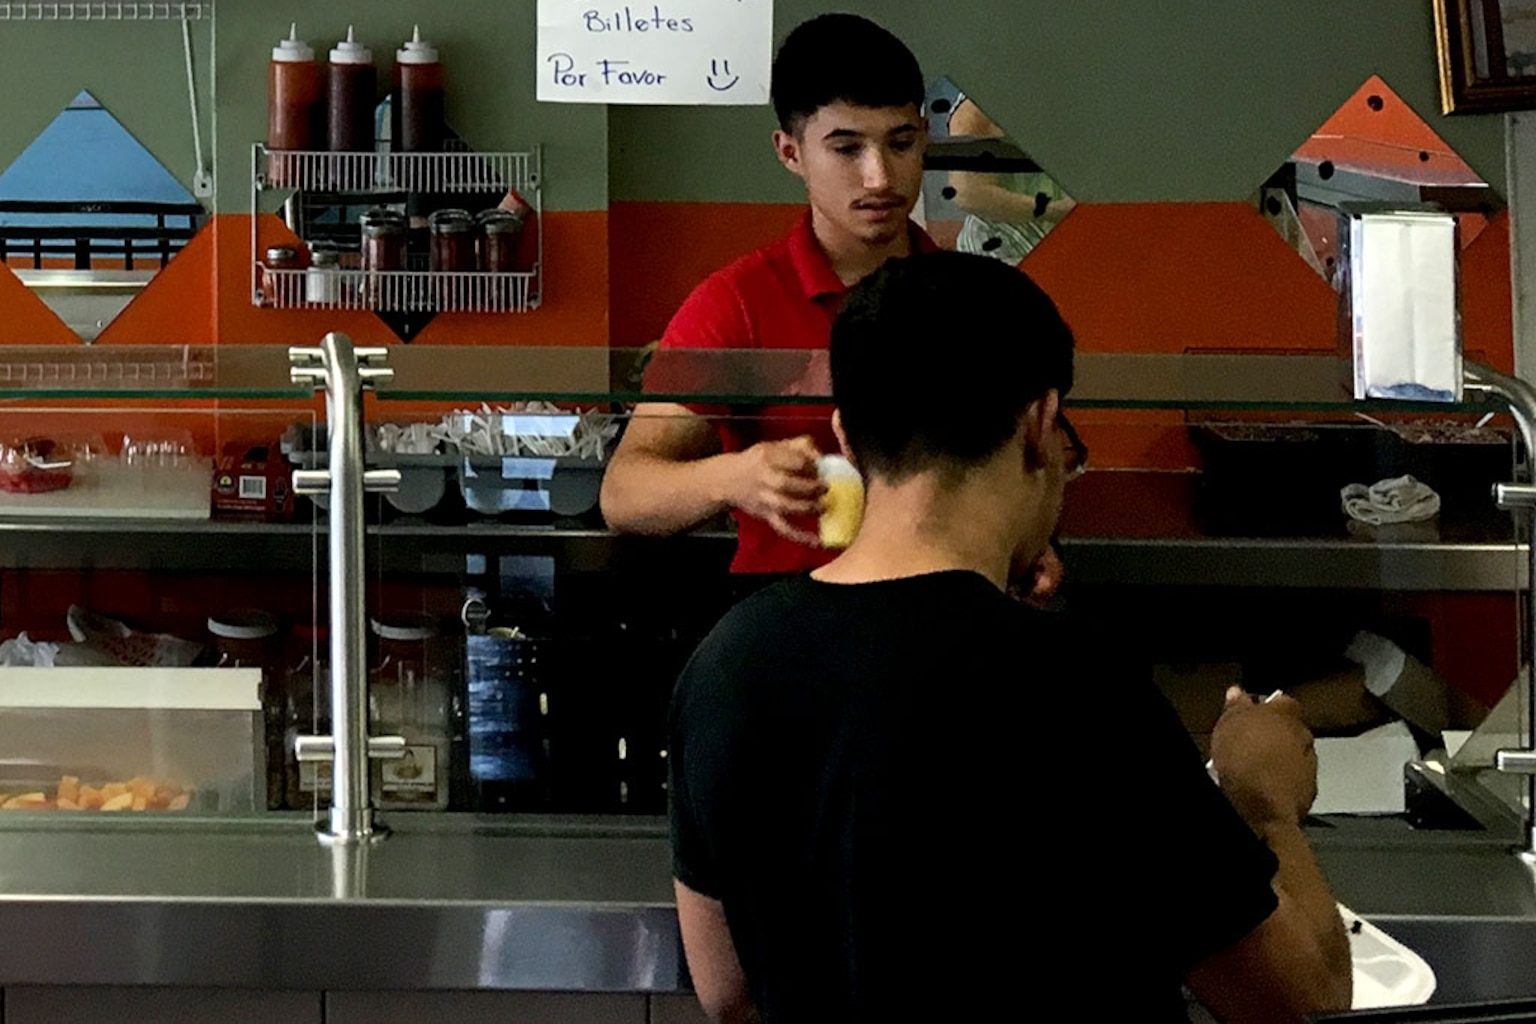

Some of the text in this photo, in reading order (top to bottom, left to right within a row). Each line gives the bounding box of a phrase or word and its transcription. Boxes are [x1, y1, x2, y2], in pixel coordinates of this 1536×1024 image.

[583, 6, 694, 33] Billetes
[548, 53, 667, 87] Por Favor
